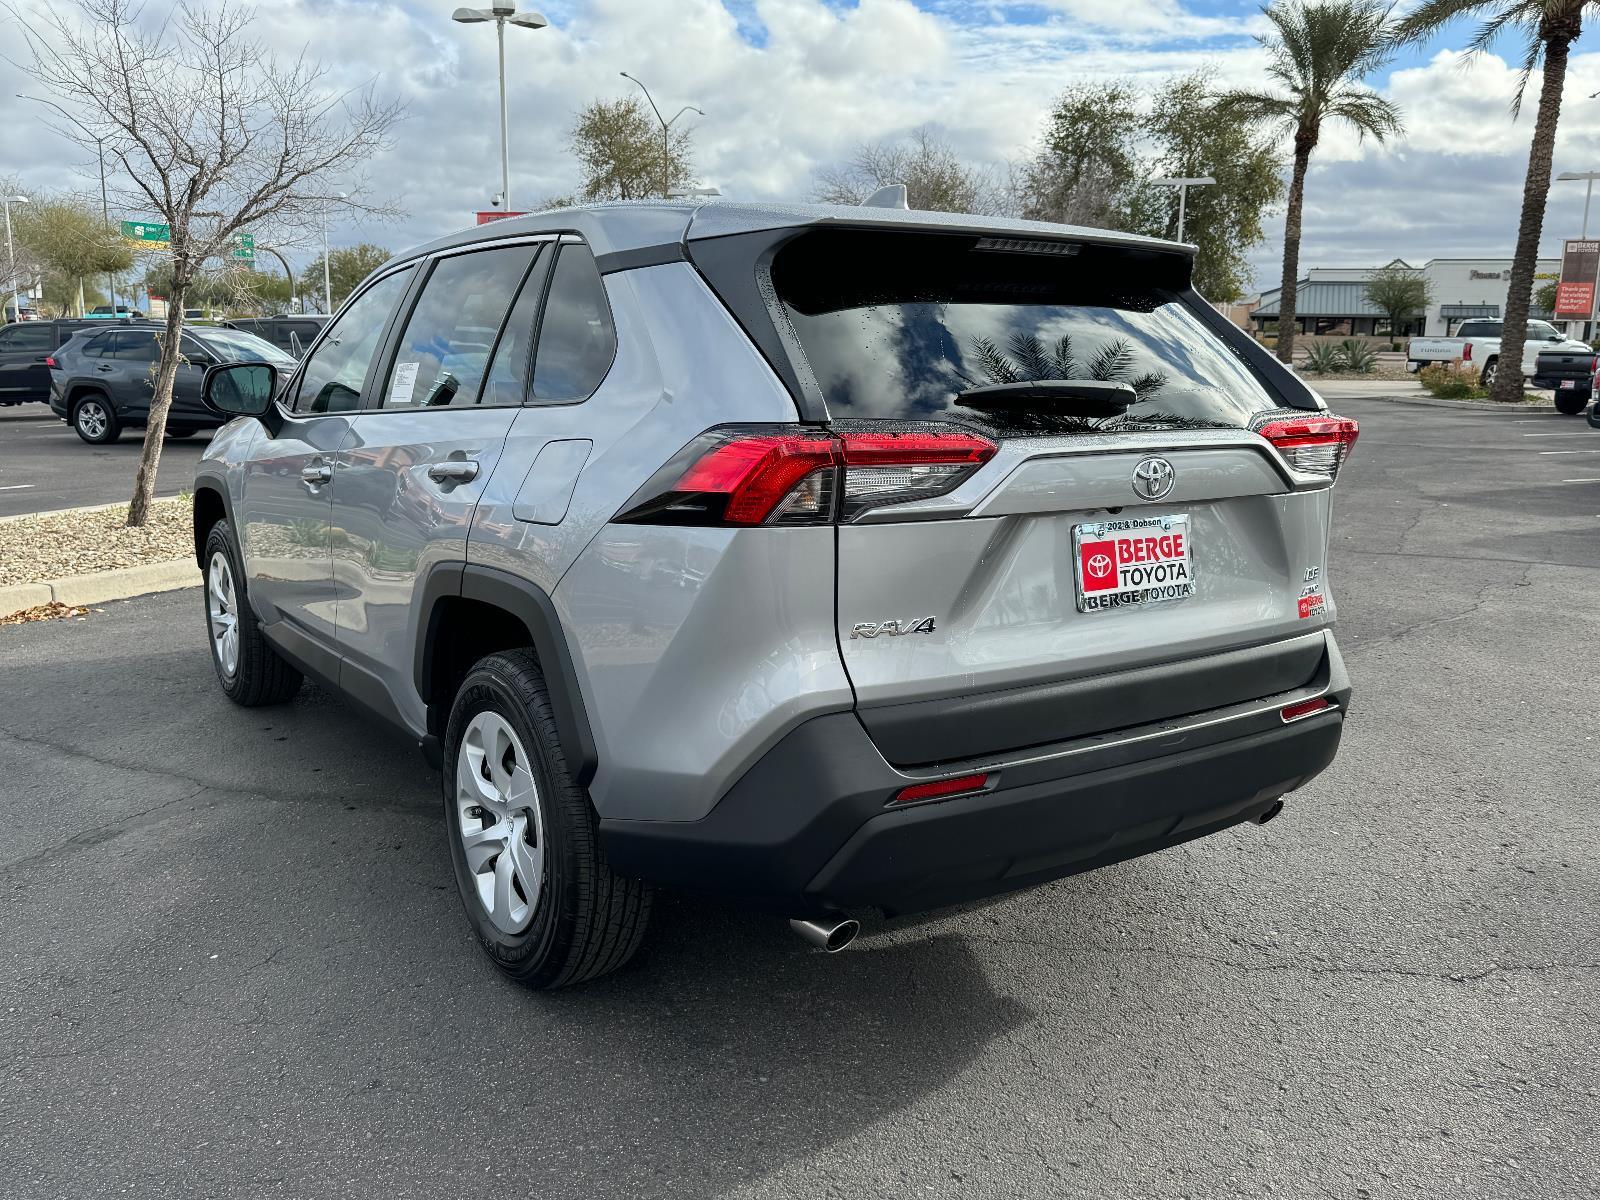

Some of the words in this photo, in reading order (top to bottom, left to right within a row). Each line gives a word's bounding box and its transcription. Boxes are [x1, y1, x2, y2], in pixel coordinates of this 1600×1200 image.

[1107, 521, 1122, 531] 202
[1123, 520, 1131, 529] &
[1133, 518, 1162, 528] Dobson
[1118, 534, 1184, 564] BERGE
[1120, 563, 1187, 586] TOYOTA
[1304, 566, 1319, 582] LE
[1087, 590, 1140, 609] BERGE
[1143, 583, 1191, 601] TOYOTA
[850, 615, 936, 640] RAV4
